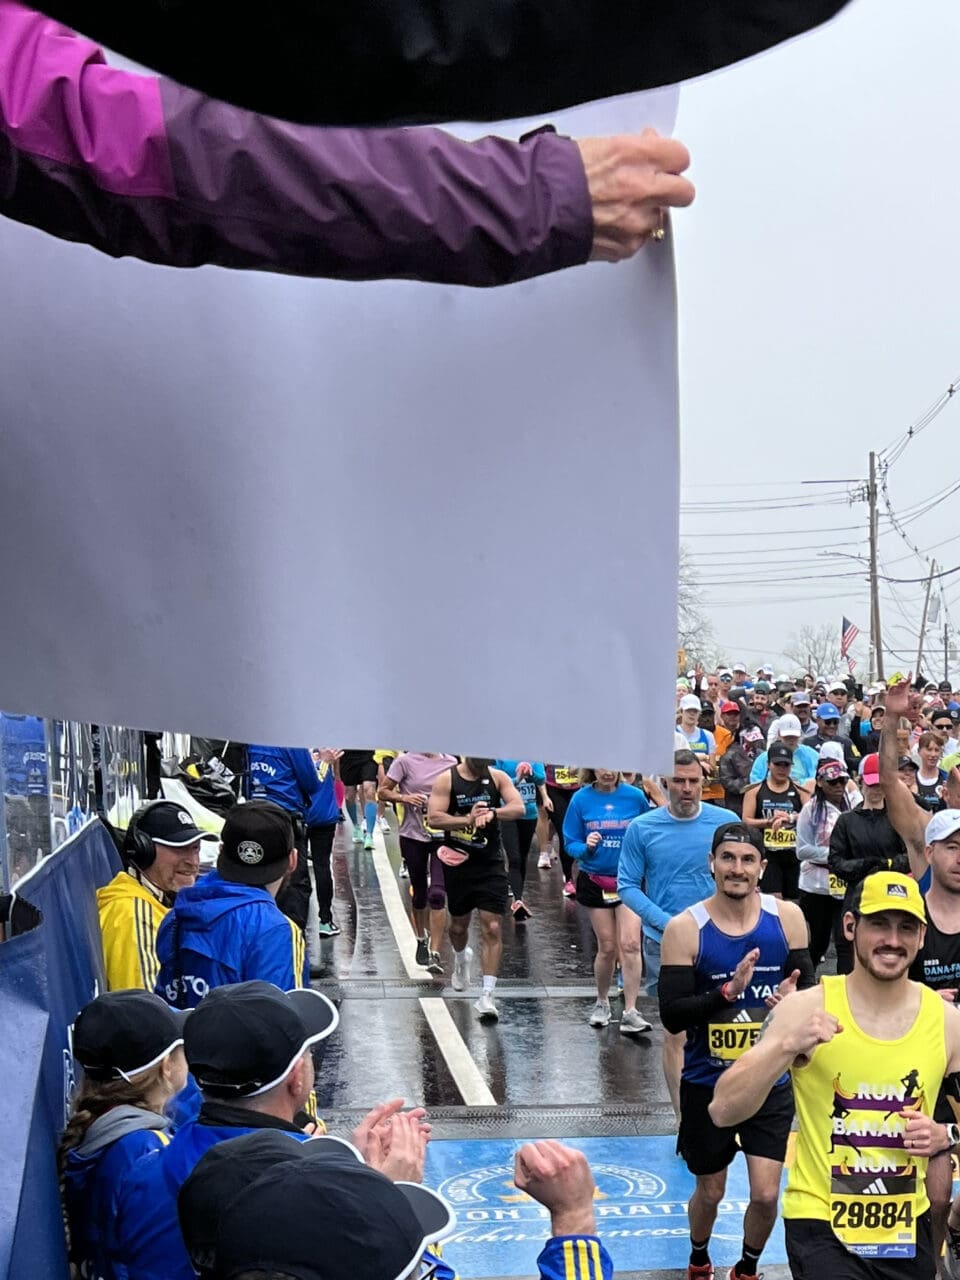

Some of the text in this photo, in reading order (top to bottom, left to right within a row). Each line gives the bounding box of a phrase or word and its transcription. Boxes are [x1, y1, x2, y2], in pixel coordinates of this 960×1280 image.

[857, 1082, 906, 1102] RUN
[854, 1156, 898, 1173] RUN
[832, 1201, 914, 1229] 29884
